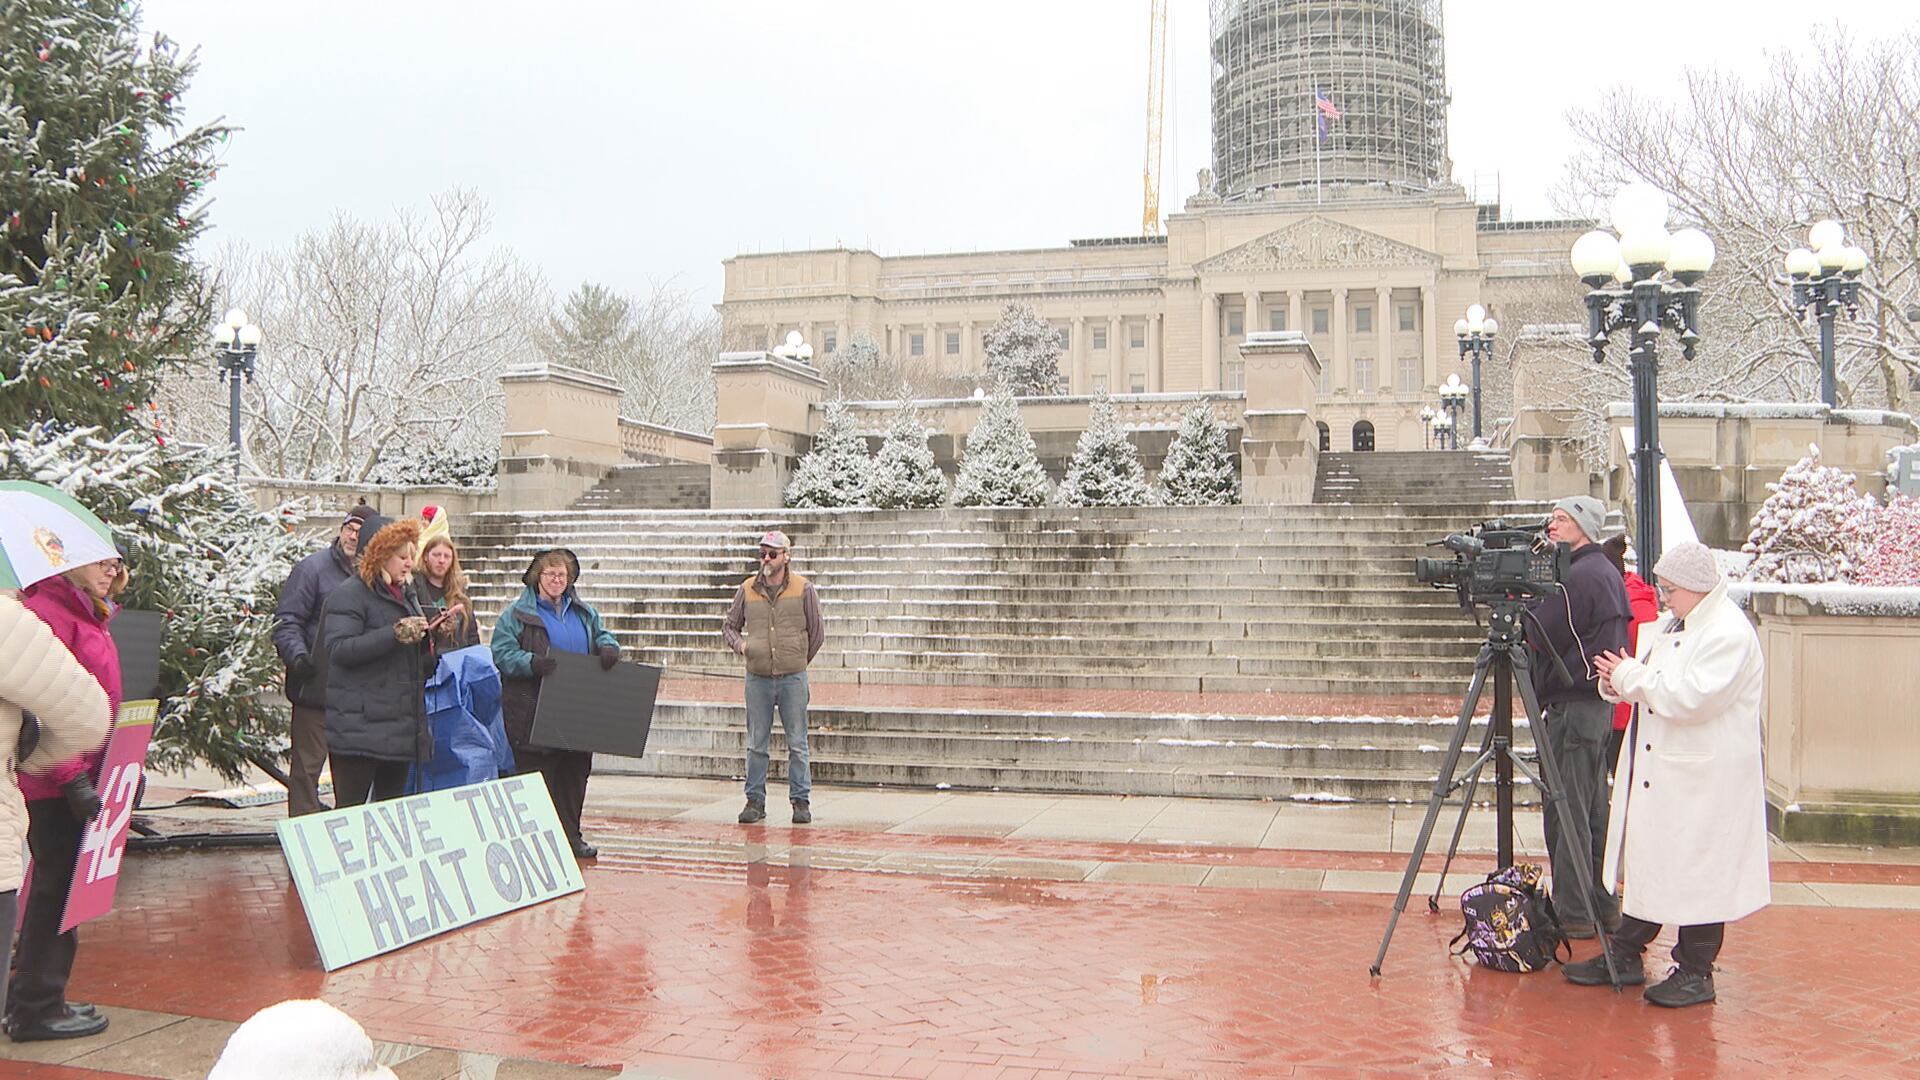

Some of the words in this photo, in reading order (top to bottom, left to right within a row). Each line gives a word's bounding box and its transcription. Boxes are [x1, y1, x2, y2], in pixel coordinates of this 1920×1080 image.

[294, 796, 445, 886] LEAVE
[453, 779, 540, 842] THE
[354, 846, 478, 950] HEAT
[485, 829, 571, 903] ON!
